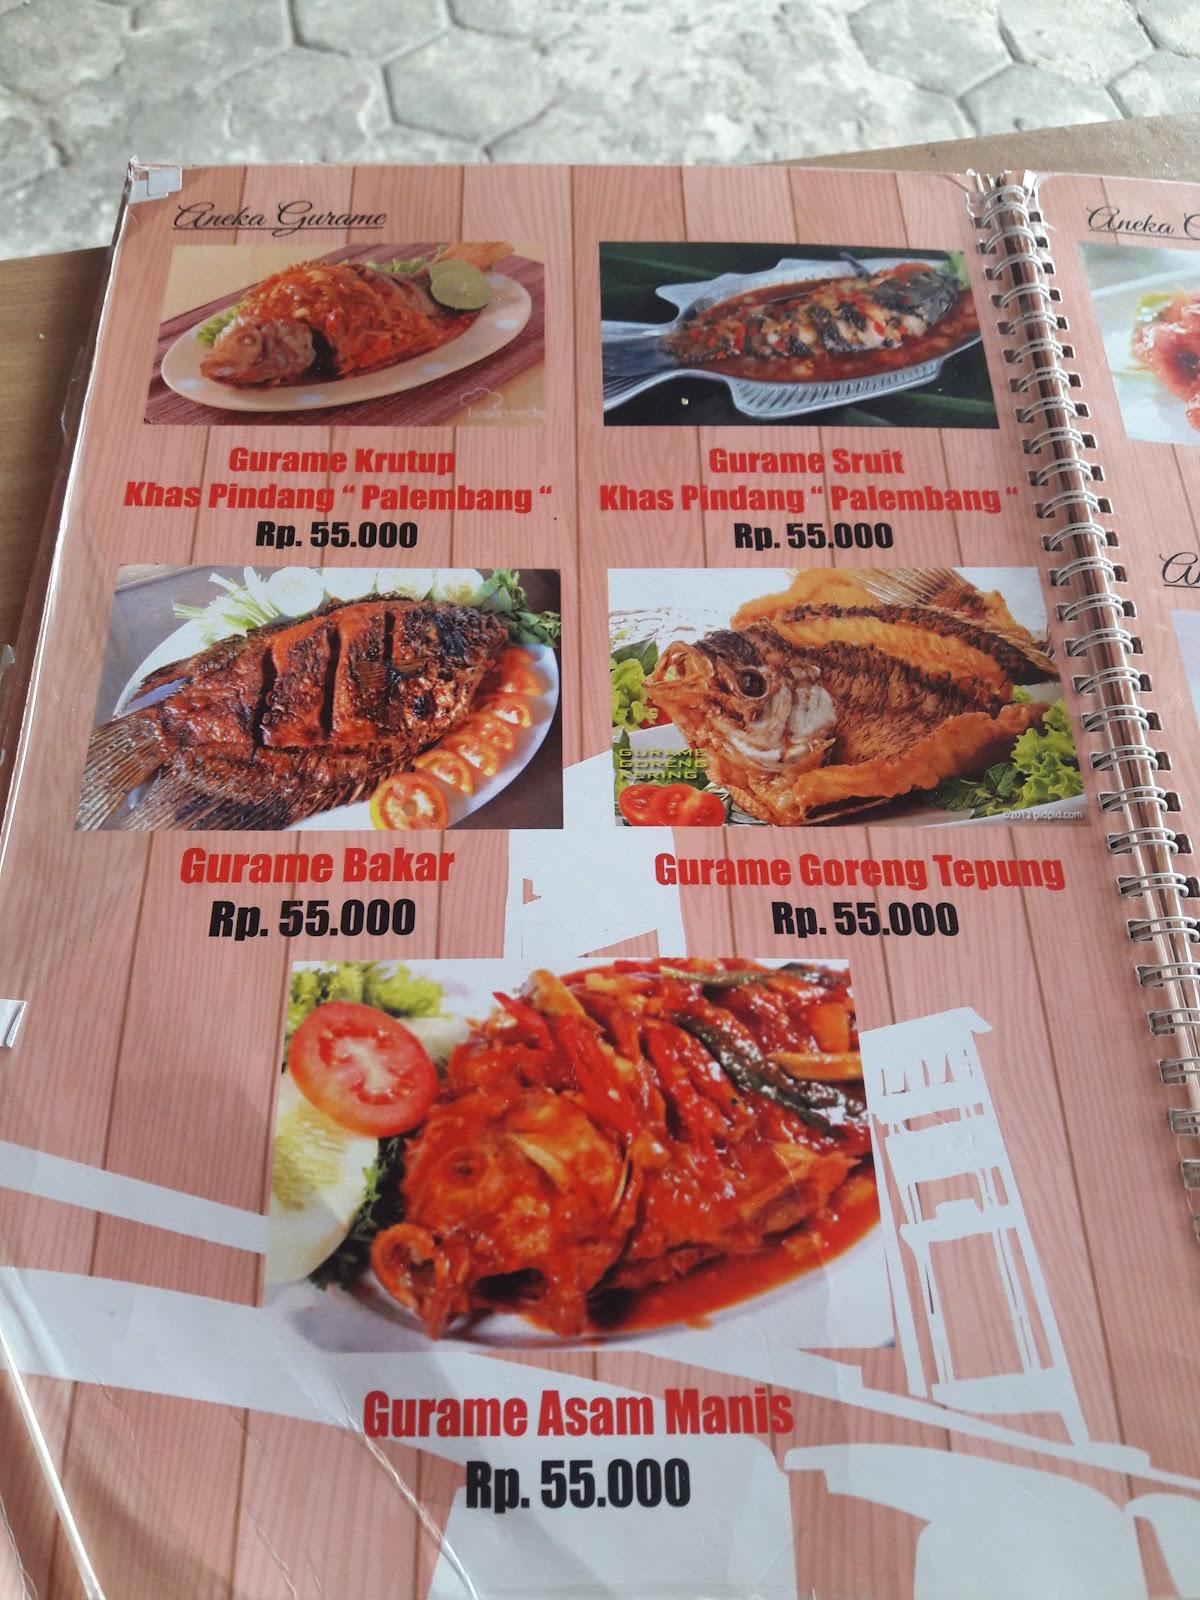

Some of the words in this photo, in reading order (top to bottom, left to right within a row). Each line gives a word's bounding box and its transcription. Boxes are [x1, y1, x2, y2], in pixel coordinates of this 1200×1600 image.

[173, 201, 267, 229] Aneka
[272, 200, 388, 237] Gurame
[1086, 206, 1174, 235] Aneka
[228, 447, 348, 474] Gurame
[354, 448, 456, 476] Krutup
[708, 447, 826, 474] Gurame
[831, 448, 905, 475] Sruit
[123, 481, 201, 508] Khas
[208, 482, 335, 513] Pindang
[361, 484, 533, 515] Palembang
[599, 484, 674, 512] Khas
[680, 484, 805, 514] Pindang
[830, 485, 1001, 513] Palembang
[255, 520, 302, 550] Rp.
[310, 521, 418, 549] 55.000
[733, 523, 781, 552] Rp.
[786, 522, 894, 549] 55.000
[619, 748, 706, 758] GURAME
[619, 759, 708, 769] GORENG
[620, 771, 699, 780] KERING
[180, 847, 334, 884] Gurame
[342, 847, 456, 883] Bakar
[655, 853, 792, 887] Gurame
[799, 853, 929, 891] Goreng
[932, 854, 1066, 891] Tepung
[208, 900, 269, 942] Rp.
[278, 898, 416, 938] 55.000
[771, 901, 827, 938] Rp.
[833, 901, 960, 937] 55.000
[365, 1391, 527, 1437] Gurame
[538, 1390, 653, 1436] Asam
[664, 1387, 795, 1435] Manis
[465, 1460, 530, 1514] Rp.
[540, 1458, 691, 1509] 55.000
